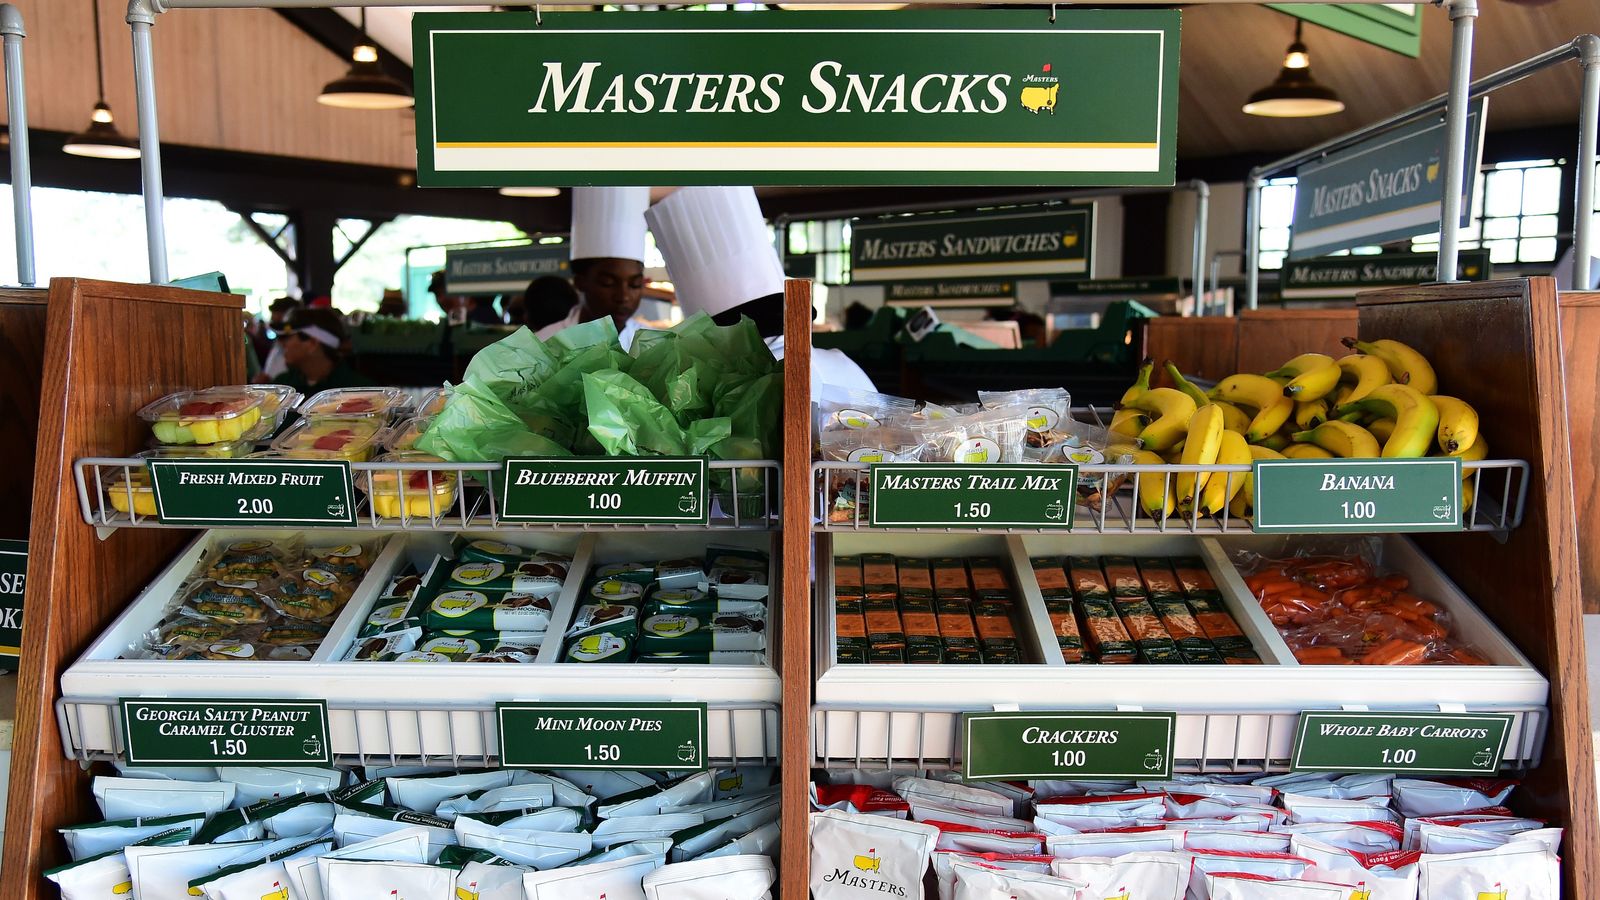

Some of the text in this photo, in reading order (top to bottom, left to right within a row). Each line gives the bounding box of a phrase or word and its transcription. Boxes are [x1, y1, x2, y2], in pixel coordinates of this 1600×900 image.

[527, 60, 1012, 114] MASTERS SNACKS
[1309, 162, 1422, 218] MASTERS SNACKS
[860, 232, 1060, 260] MASTERS SANDWICHES
[1289, 262, 1463, 282] MASTERS SANDWIC
[179, 471, 324, 486] FRESH MIXED FRUIT
[514, 469, 697, 486] BLUEBERRY MUFFIN
[879, 474, 1062, 491] MASTERS TRAIL MIX
[1319, 473, 1395, 491] BANANA
[237, 498, 274, 514] 2.00
[587, 493, 622, 510] 1.00
[953, 502, 991, 518] 1.50
[1341, 501, 1376, 519] 1.00
[136, 707, 311, 722] GEORGIA SALTY PEANUT
[159, 722, 295, 736] CARAMEL CLUSTER
[534, 717, 663, 732] MINI MOON PIES
[1320, 723, 1489, 739] WHOLE BABY CARROTS
[1021, 726, 1119, 744] CRACKERS
[210, 739, 247, 756] 1.50
[584, 744, 621, 761] 1.50
[1381, 748, 1417, 764] 1.00
[1051, 750, 1086, 767] 1.00
[823, 868, 906, 898] MASTERS
